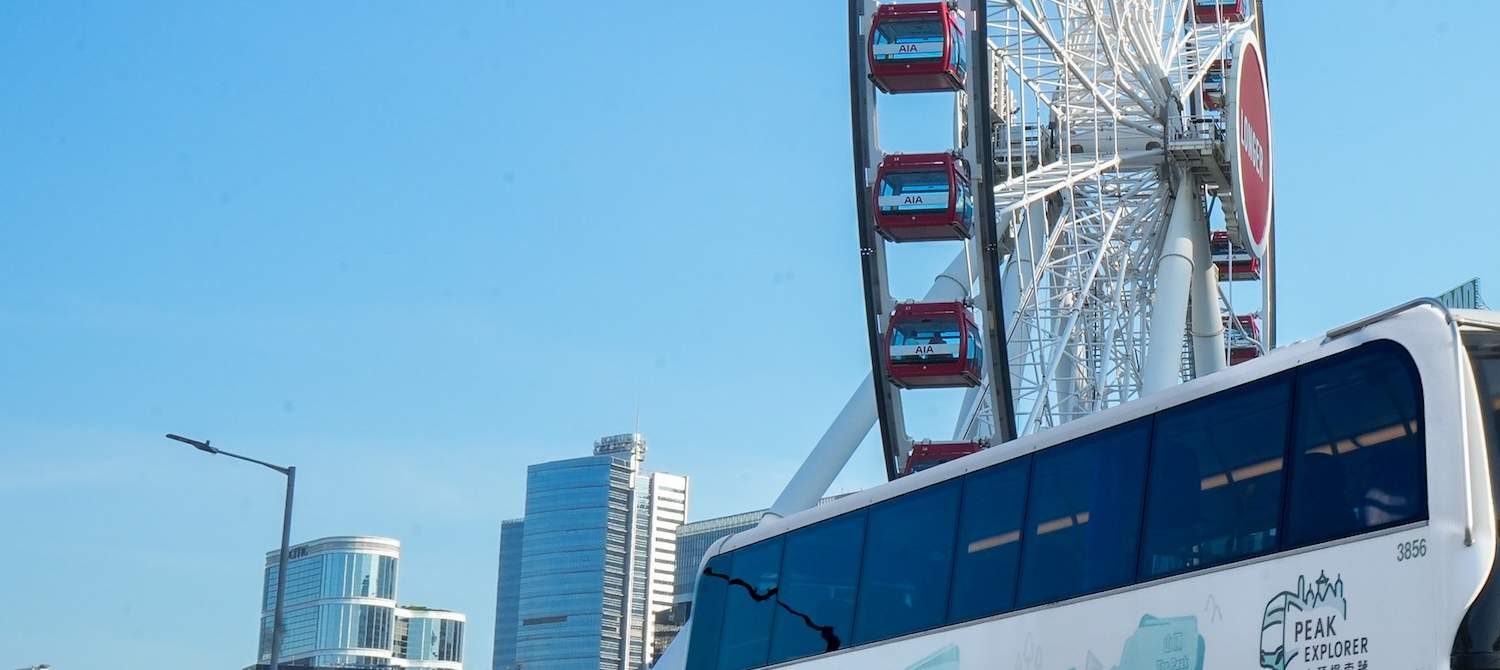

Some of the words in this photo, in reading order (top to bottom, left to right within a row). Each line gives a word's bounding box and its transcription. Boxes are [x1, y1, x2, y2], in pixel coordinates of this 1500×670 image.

[899, 44, 918, 53] AIA
[904, 195, 923, 205] AIA
[915, 345, 934, 355] AIA
[1397, 538, 1427, 562] 3856
[1295, 614, 1337, 642] PEAK
[1305, 637, 1368, 663] EXPLORER
